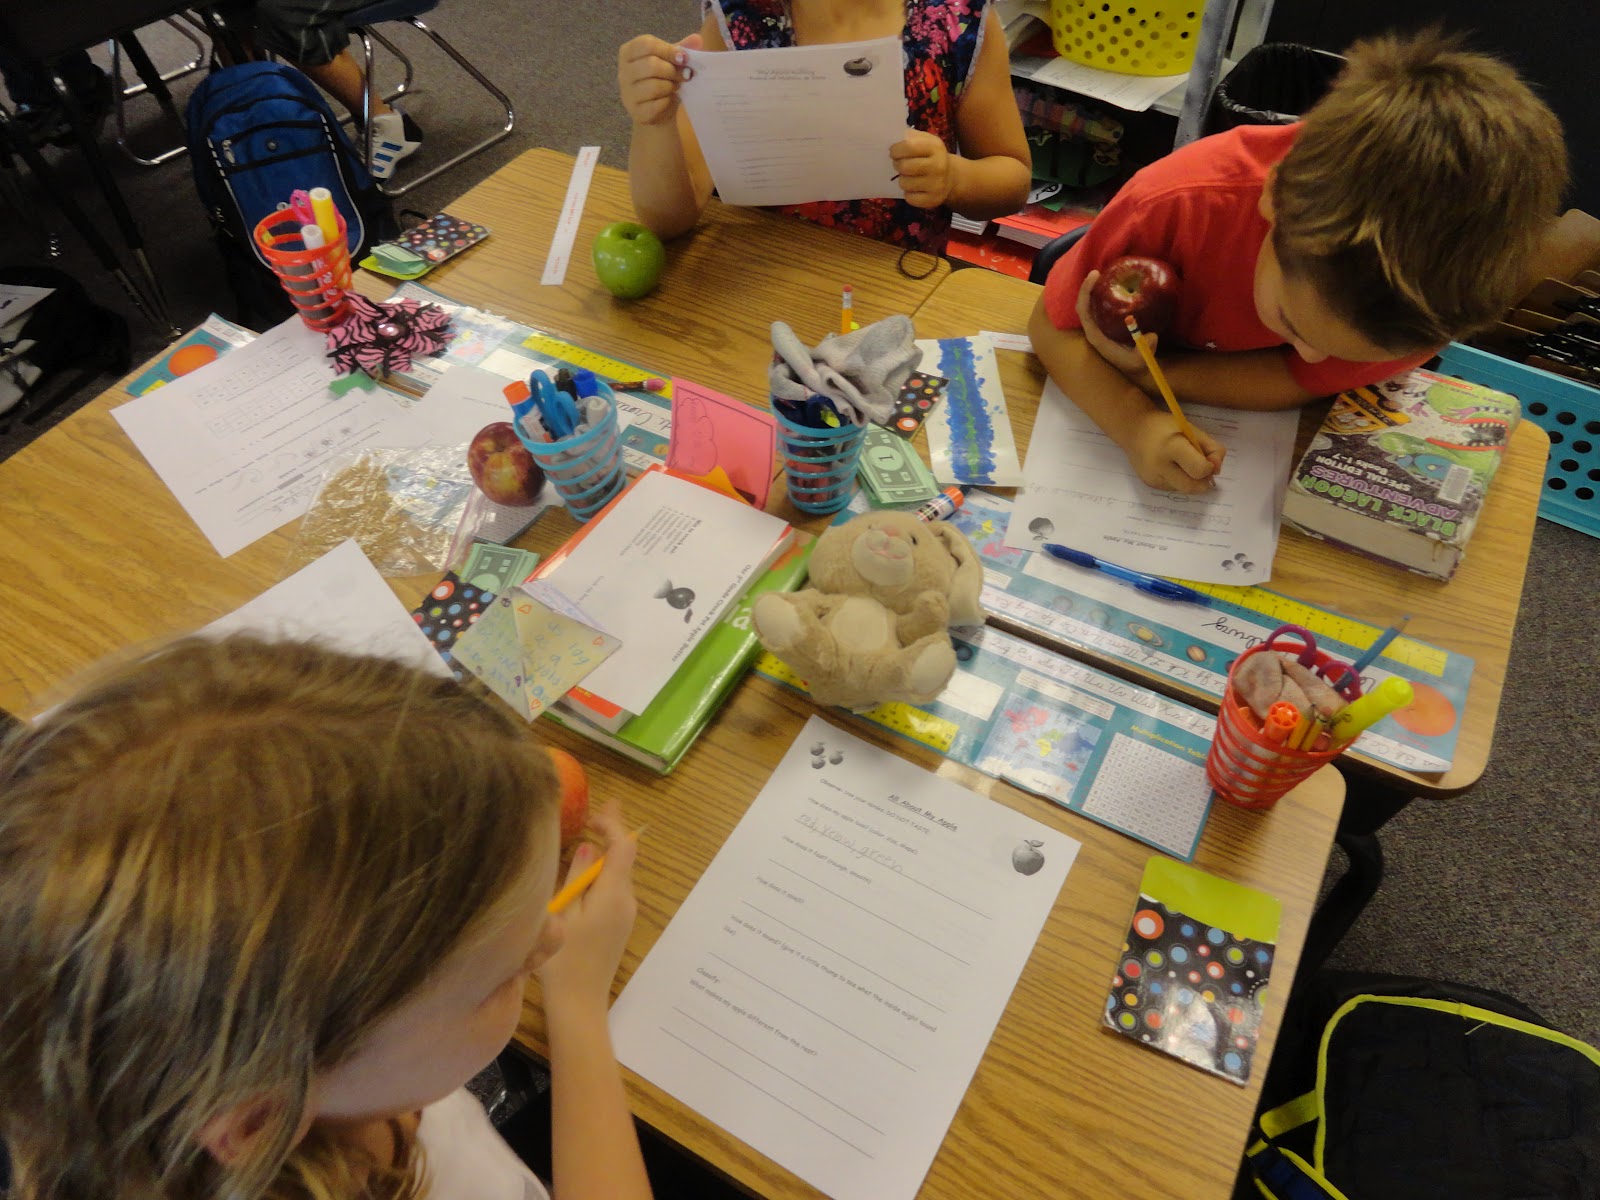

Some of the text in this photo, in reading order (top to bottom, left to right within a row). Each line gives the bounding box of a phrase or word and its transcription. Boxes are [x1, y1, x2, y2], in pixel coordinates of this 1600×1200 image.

[1313, 452, 1413, 493] SPECIAL EDITION
[1353, 456, 1389, 476] Books
[1298, 472, 1458, 538] BLACK LAGOON
[1307, 462, 1461, 522] ADVENTURES
[683, 623, 702, 644] Apple
[698, 614, 711, 627] Pot
[668, 640, 689, 664] Butter
[1128, 723, 1186, 752] Multiplication
[884, 809, 896, 818] DO
[894, 813, 910, 825] NOT
[886, 791, 959, 833] All About My Apple
[687, 977, 706, 992] What
[730, 1003, 747, 1017] apple
[745, 1011, 775, 1033] different
[772, 1027, 790, 1041] from
